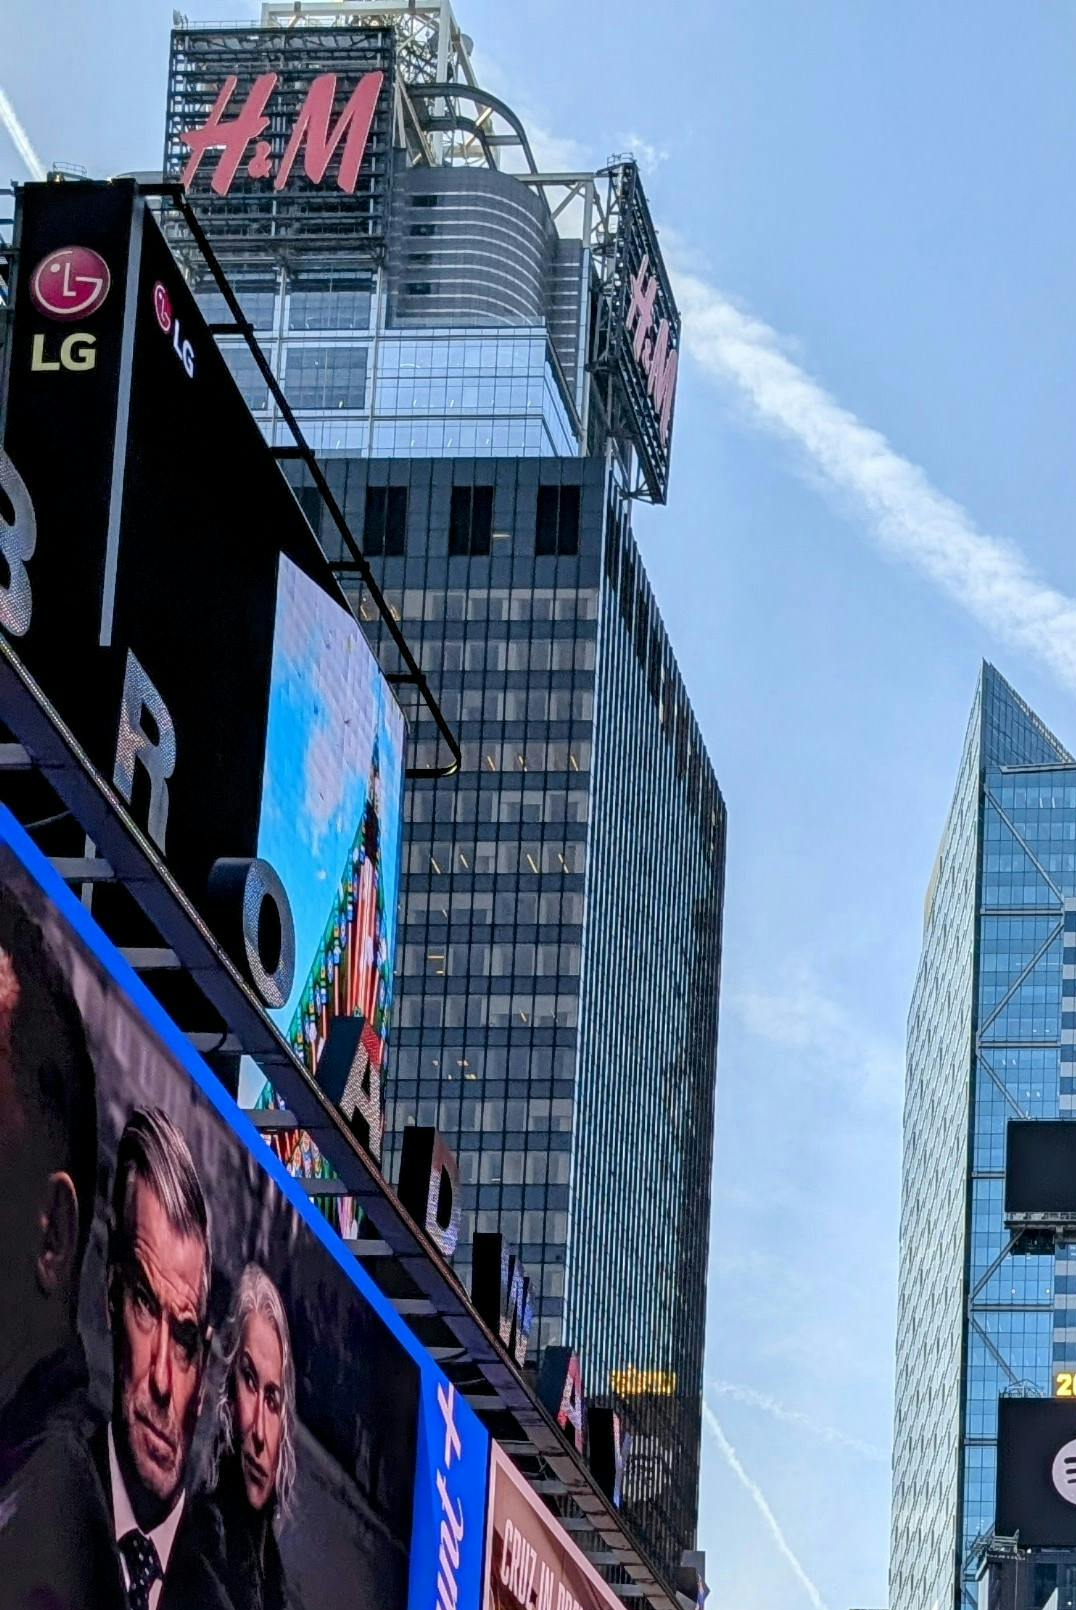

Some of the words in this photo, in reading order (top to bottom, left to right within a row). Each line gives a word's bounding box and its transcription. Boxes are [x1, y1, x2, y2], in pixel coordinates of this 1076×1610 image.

[178, 70, 385, 197] H&M
[31, 333, 97, 373] LG
[173, 318, 195, 379] LG
